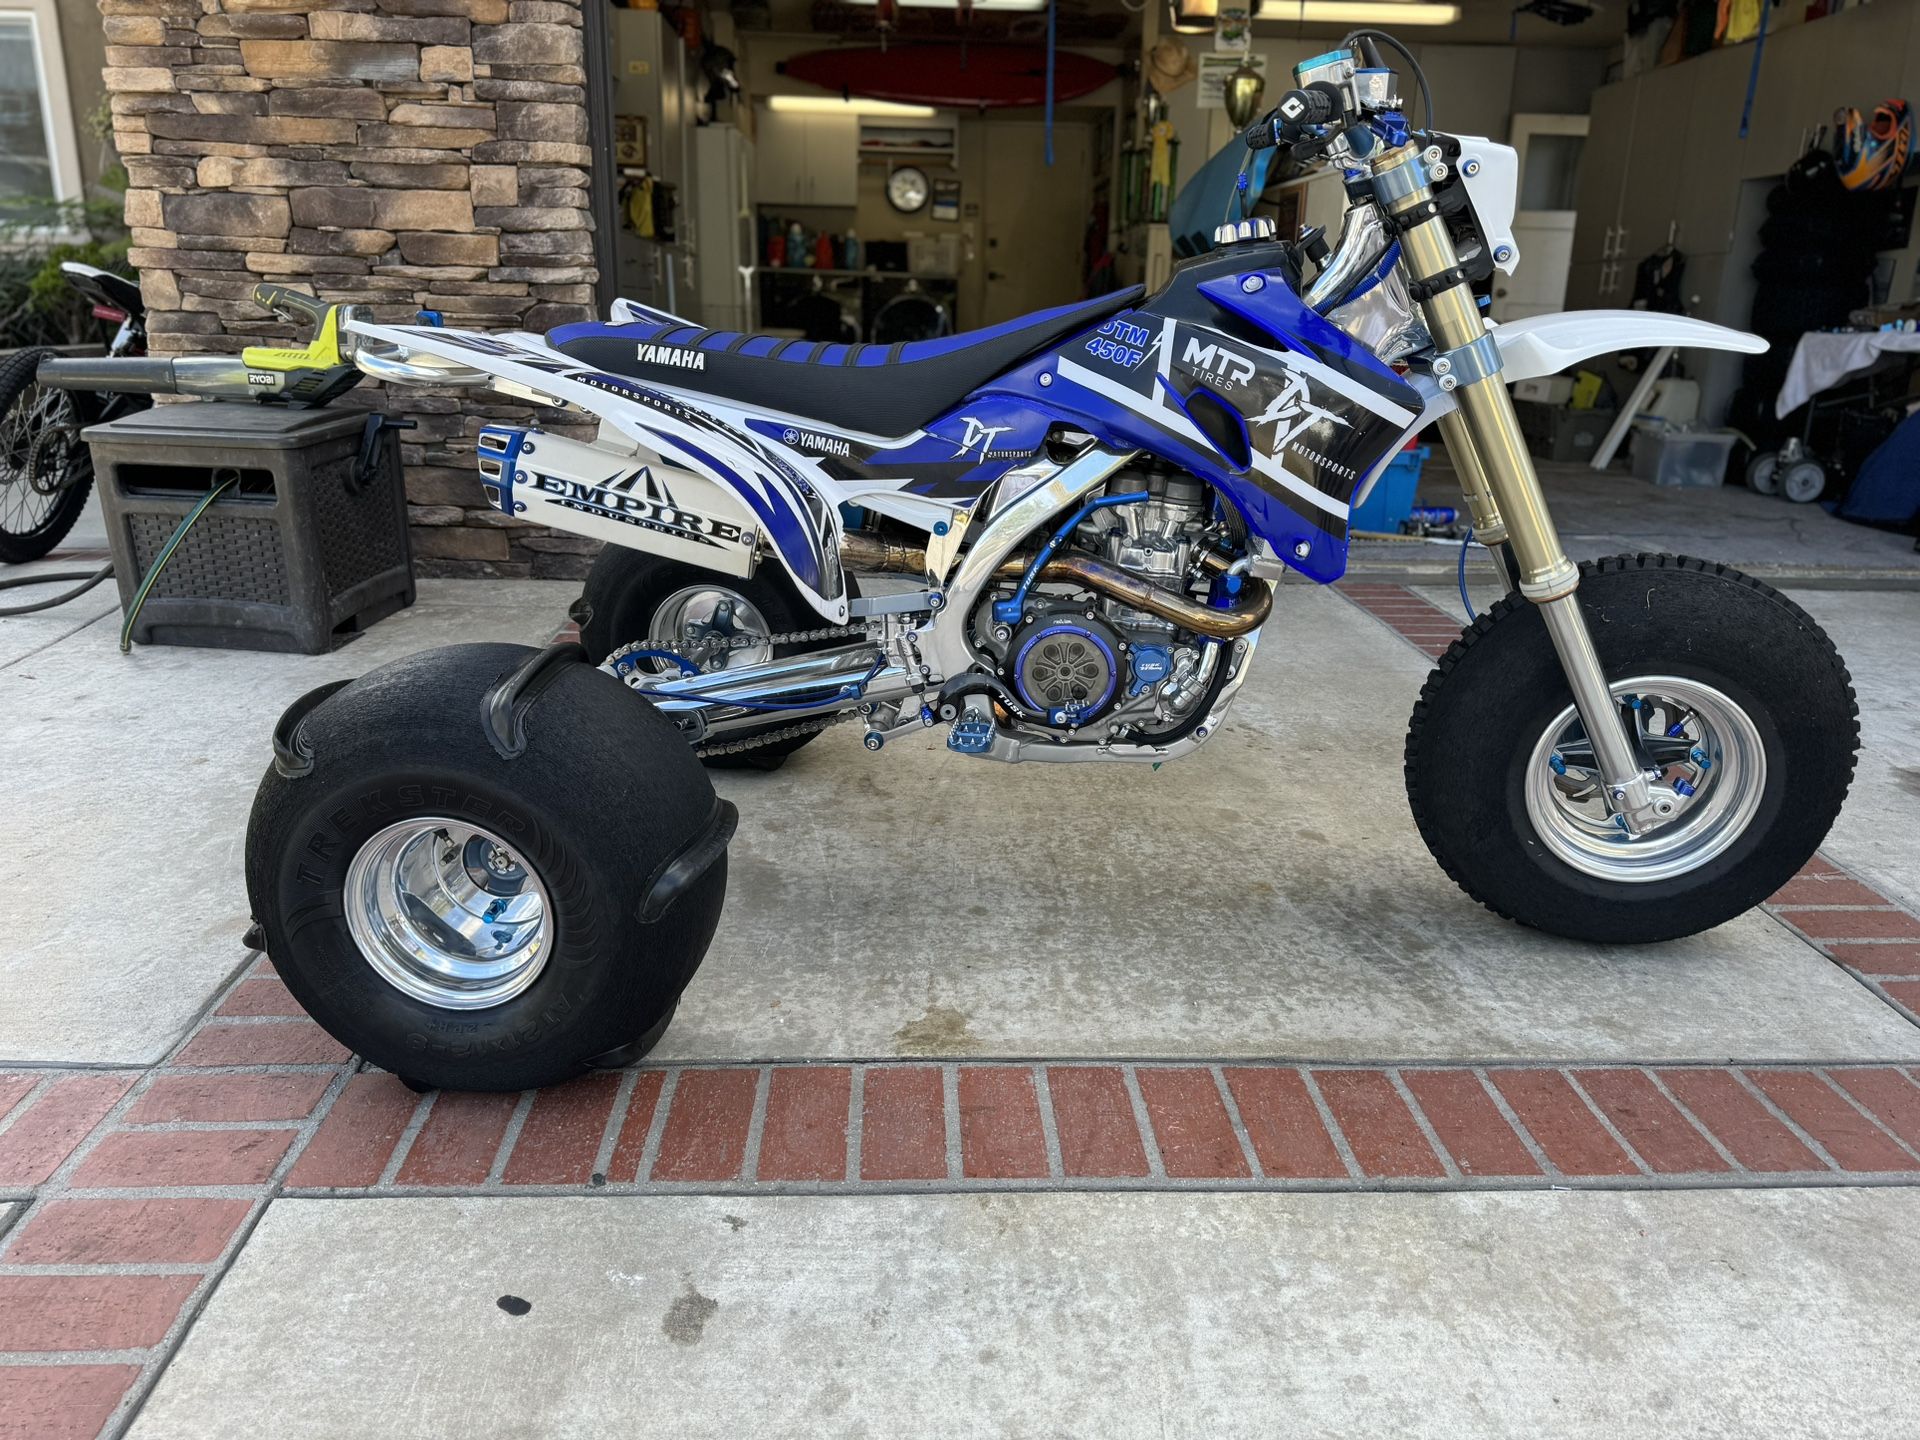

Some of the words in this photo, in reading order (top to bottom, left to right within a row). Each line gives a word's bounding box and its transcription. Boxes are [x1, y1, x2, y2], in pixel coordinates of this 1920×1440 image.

[637, 343, 705, 371] YAMAHA
[1085, 337, 1143, 367] 450F
[1182, 337, 1256, 387] MTR
[248, 374, 275, 385] RYOBI
[1192, 366, 1235, 391] TIRES
[576, 376, 691, 420] MOTORSPORTS
[800, 432, 850, 458] YAMAHA
[1291, 441, 1356, 480] MOTORSPORTS
[528, 470, 742, 543] EMPIRE
[1023, 564, 1040, 590] TUSK
[998, 689, 1026, 719] TUSK
